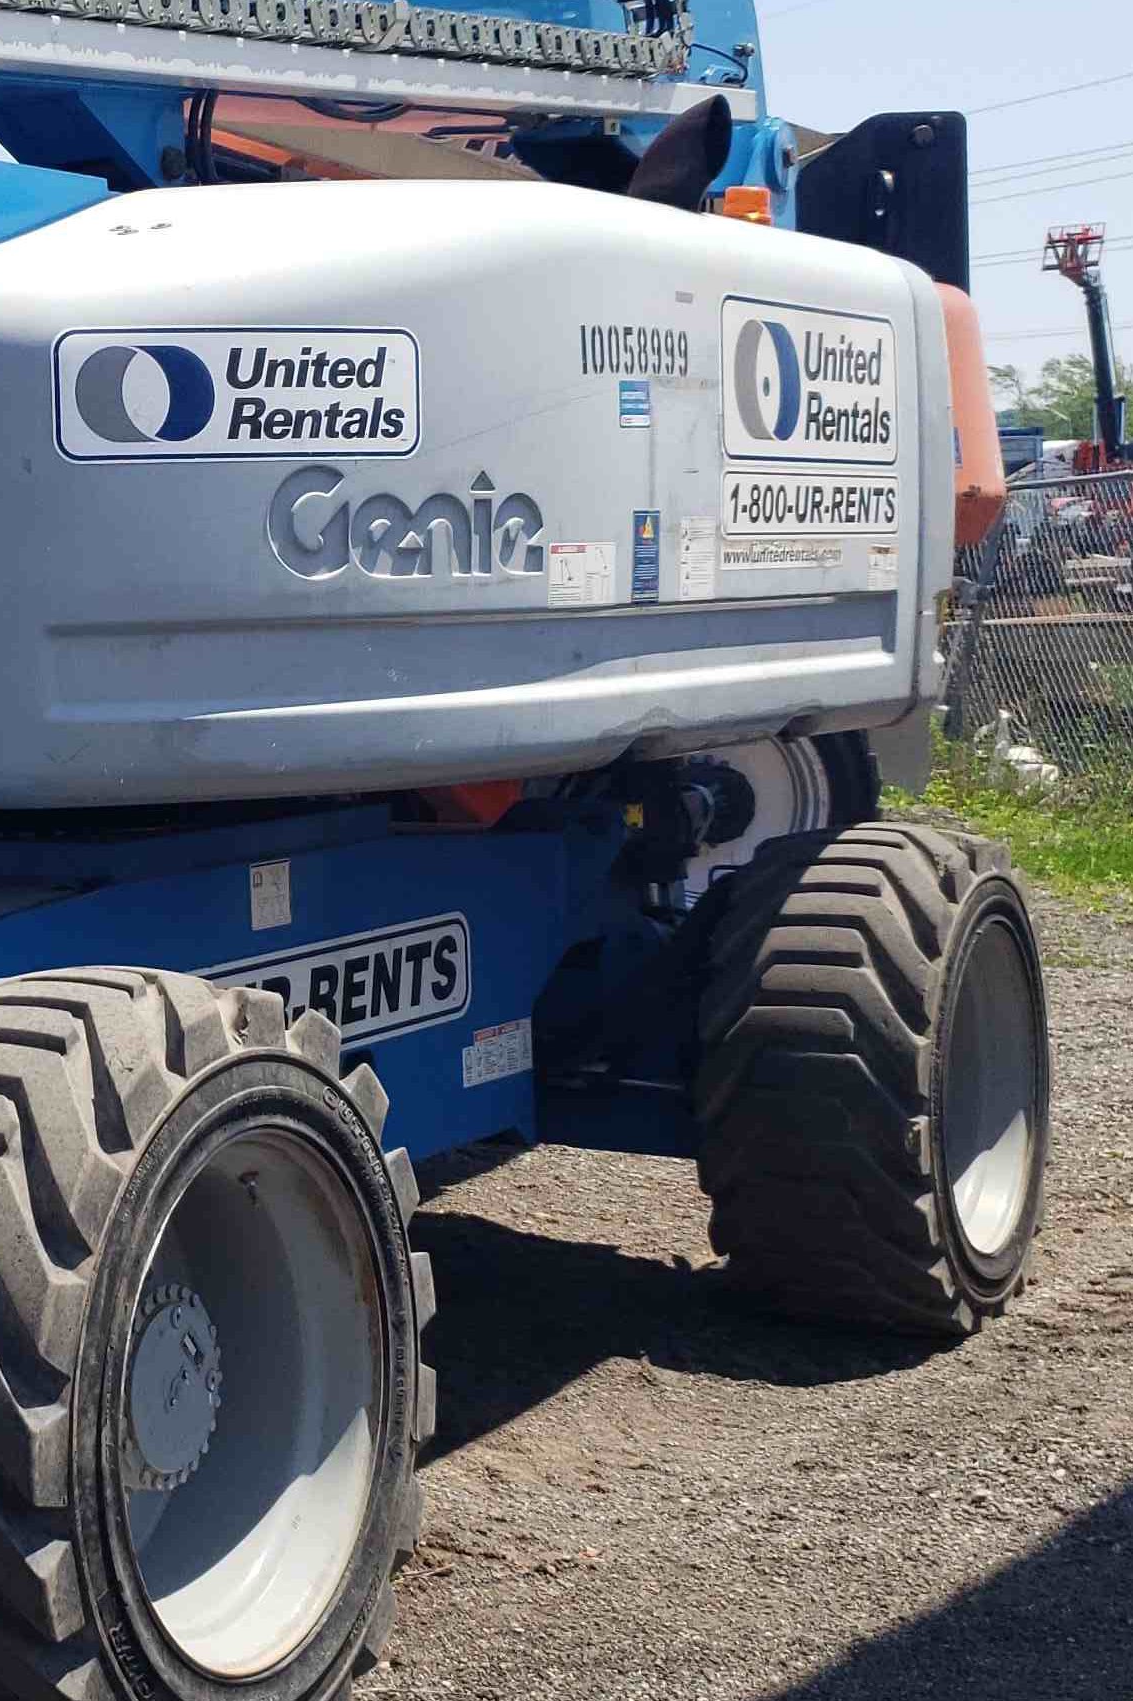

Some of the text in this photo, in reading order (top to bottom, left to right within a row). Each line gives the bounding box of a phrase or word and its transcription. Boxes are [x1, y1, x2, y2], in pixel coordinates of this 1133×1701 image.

[226, 346, 387, 390] United
[580, 324, 688, 377] 10058999
[804, 331, 882, 386] United
[227, 396, 406, 440] Rentals
[805, 391, 891, 443] Rentals
[267, 464, 544, 580] Genie
[730, 482, 896, 524] 1-800-UR-RENTS
[244, 934, 457, 1032] R-RENTS
